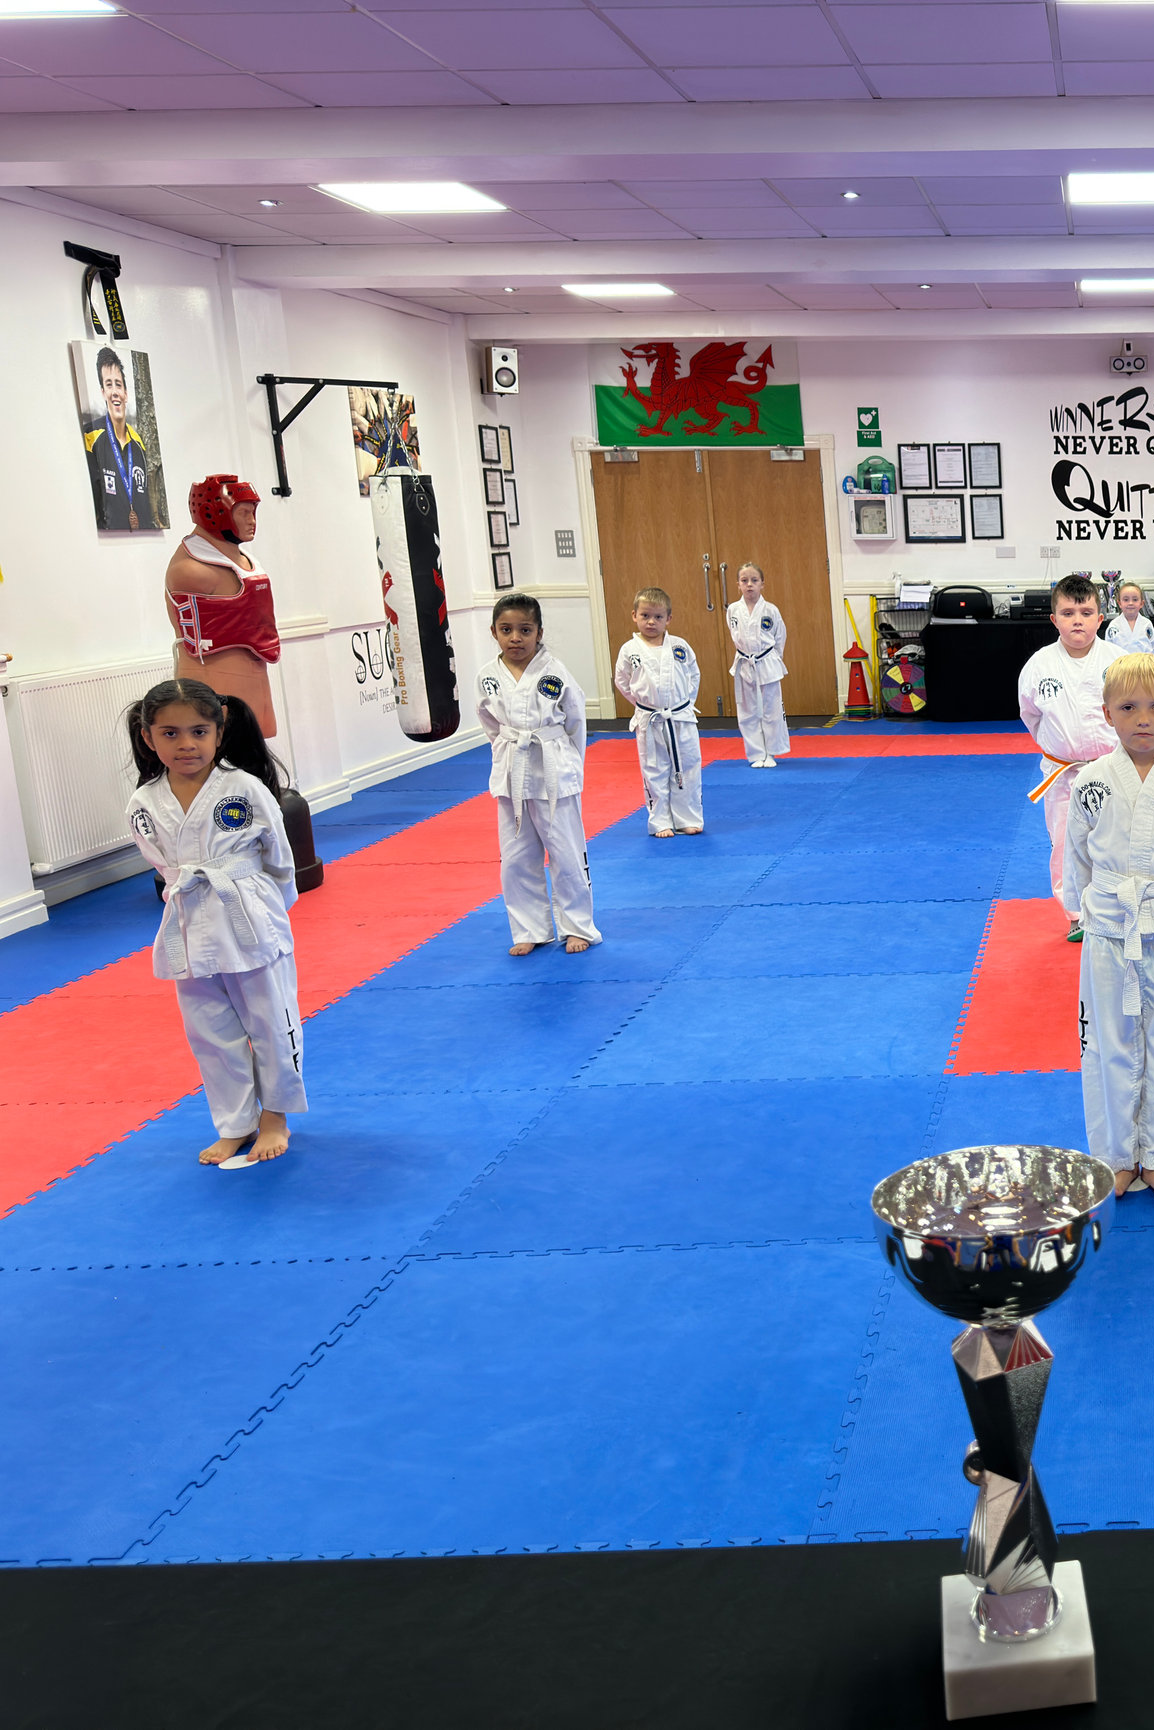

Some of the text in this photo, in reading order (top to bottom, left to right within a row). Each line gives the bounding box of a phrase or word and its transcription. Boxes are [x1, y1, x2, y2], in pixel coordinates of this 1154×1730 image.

[1053, 436, 1140, 455] NEVER
[1056, 520, 1146, 540] NEVER
[393, 632, 408, 705] Pro Boxing Gear
[285, 1008, 299, 1073] ITF
